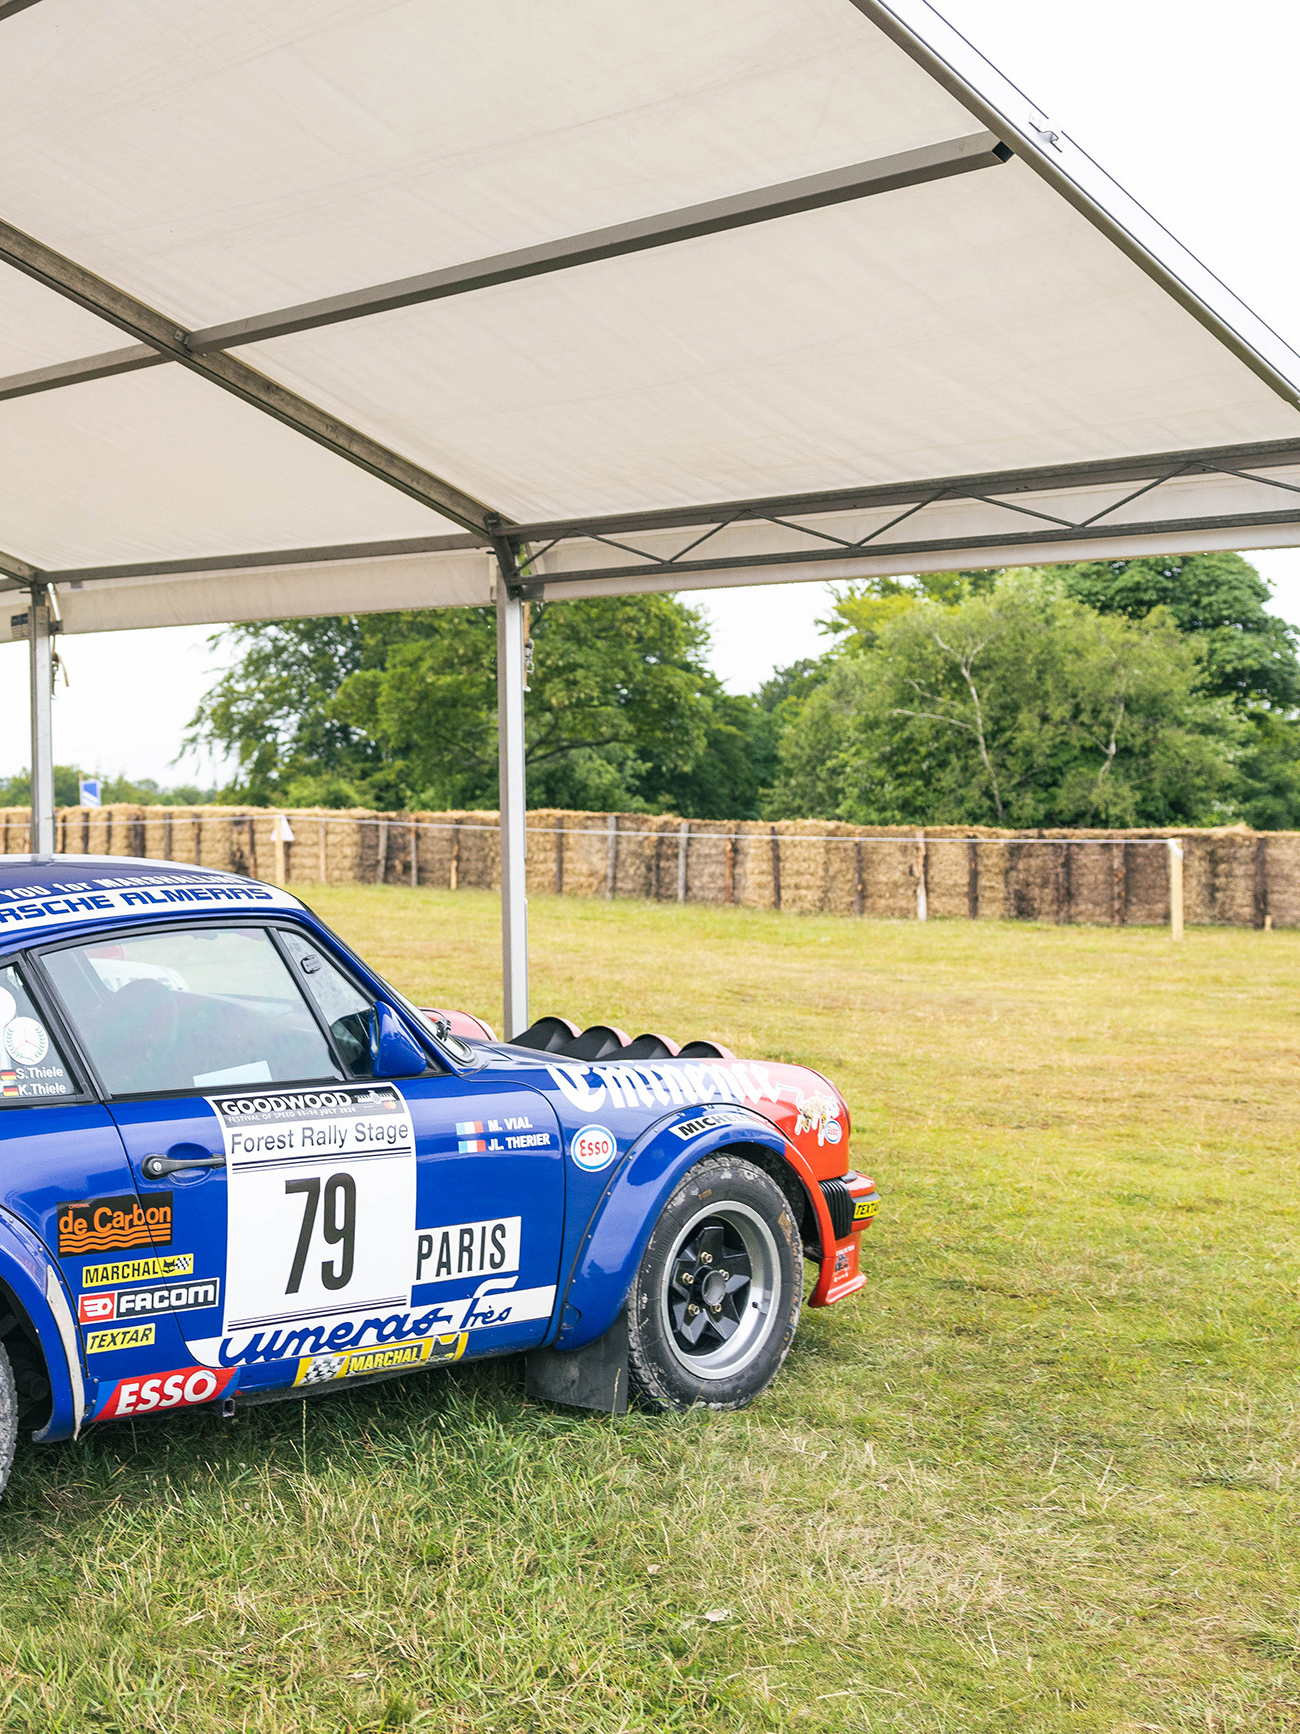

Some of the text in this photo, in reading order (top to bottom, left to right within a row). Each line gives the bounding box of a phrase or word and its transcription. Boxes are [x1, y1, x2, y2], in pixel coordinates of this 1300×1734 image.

[91, 874, 249, 889] MARSHALLING
[119, 887, 273, 906] ALMERAS
[221, 1092, 352, 1116] GOODWOOD
[227, 1115, 261, 1123] FESTIVAL
[319, 1108, 337, 1117] JULY
[488, 1117, 533, 1132] M. VIAL
[231, 1122, 409, 1154] Forest Rally Stage
[488, 1133, 551, 1151] JL. THERIER
[579, 1139, 608, 1157] Esso
[59, 1203, 171, 1235] de Carbon
[284, 1172, 357, 1295] 79
[415, 1223, 507, 1280] PARIS
[85, 1262, 159, 1284] MARCHAL
[119, 1284, 215, 1313] FACOM
[89, 1327, 153, 1350] TEXTAR
[349, 1346, 419, 1371] MARCHAL
[115, 1369, 218, 1416] ESSO
